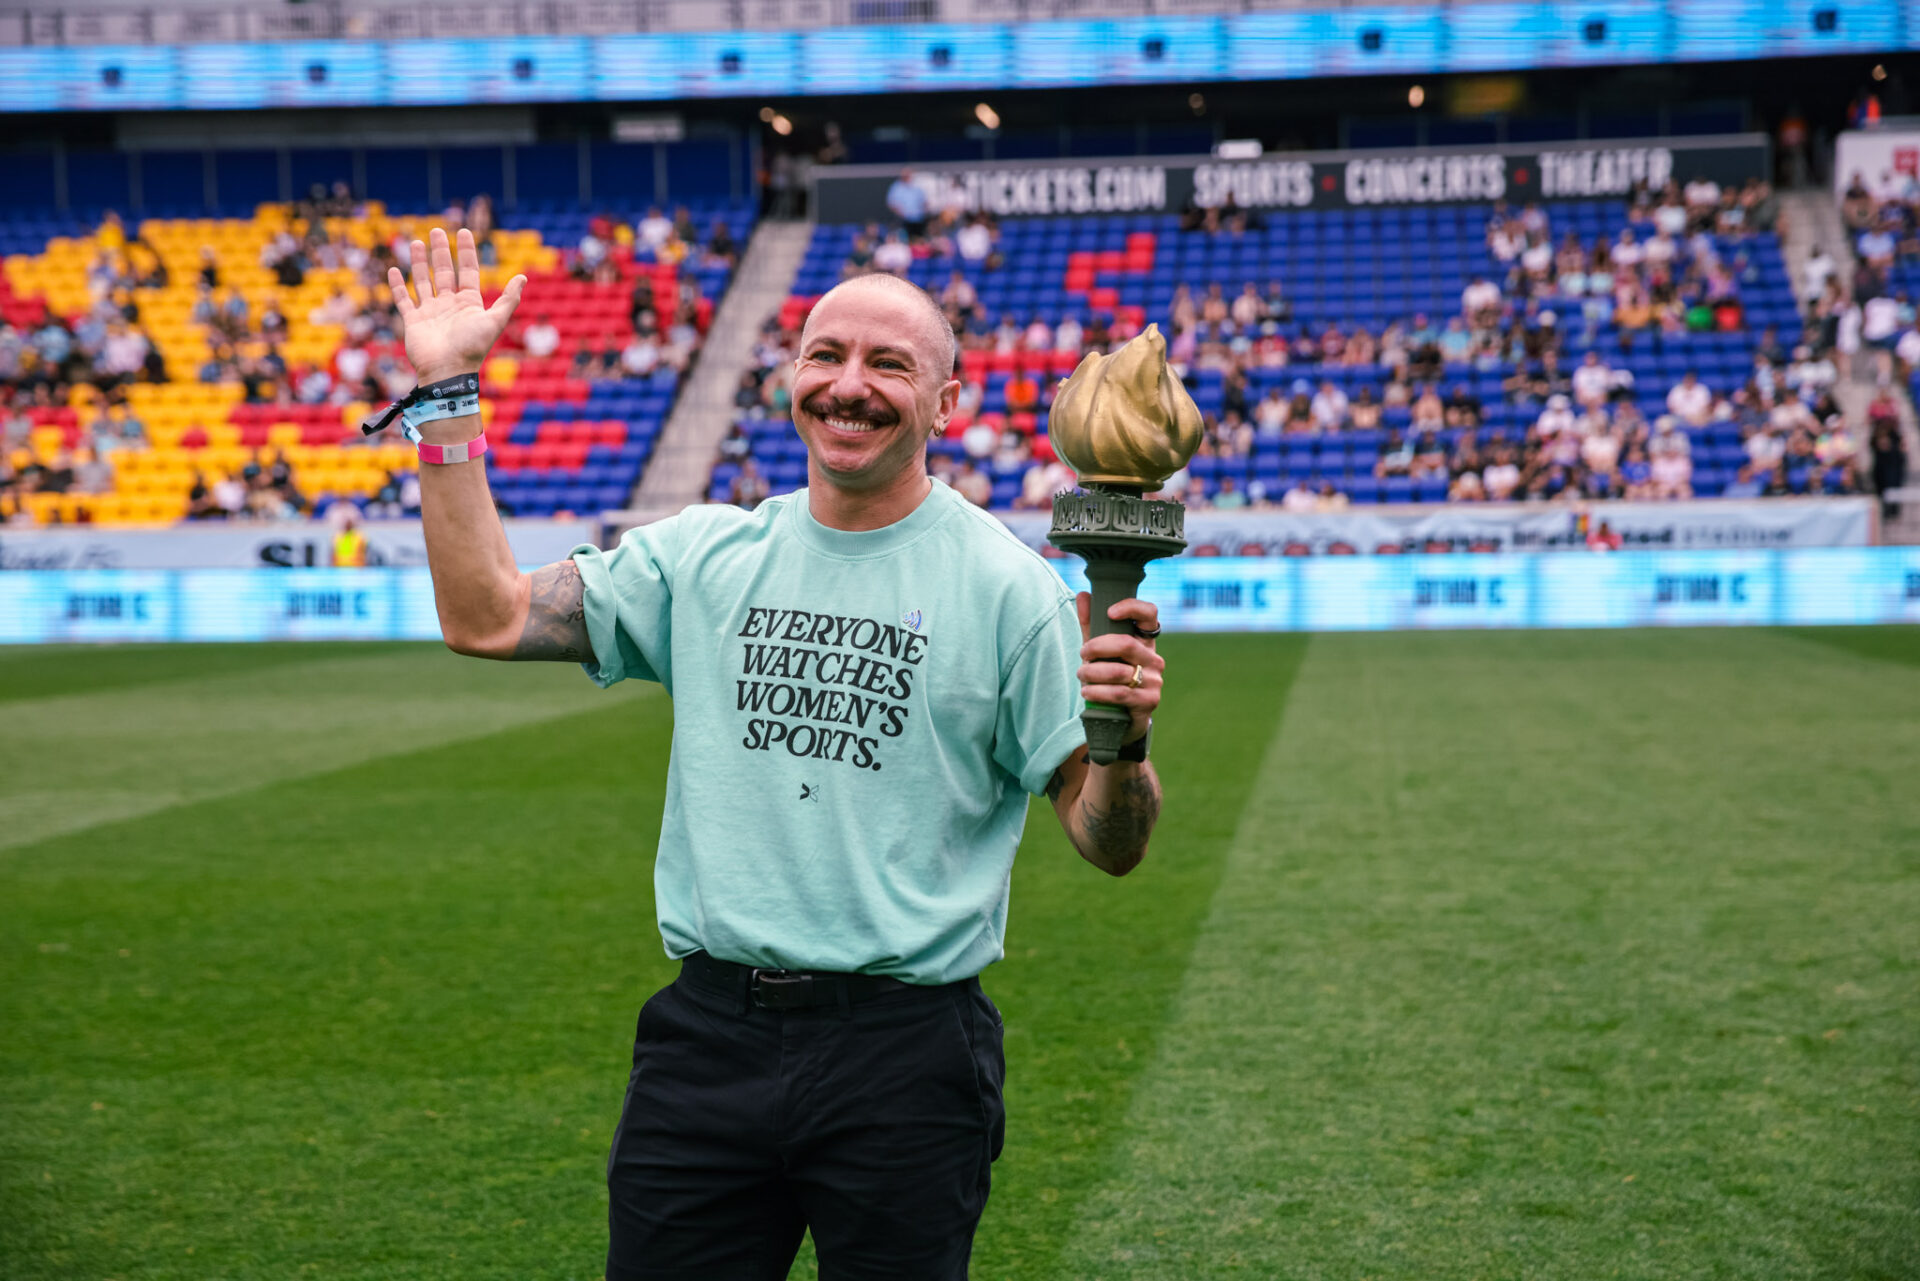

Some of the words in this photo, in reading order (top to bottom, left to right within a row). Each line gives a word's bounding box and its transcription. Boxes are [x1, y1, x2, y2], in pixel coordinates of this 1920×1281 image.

[1193, 162, 1313, 208] SPORTS
[1345, 154, 1507, 204] CONCERTS
[738, 607, 928, 665] EVERYONE
[743, 643, 914, 700] WATCHES
[736, 680, 909, 738] WOMEN'S
[742, 718, 882, 772] SPORTS.
